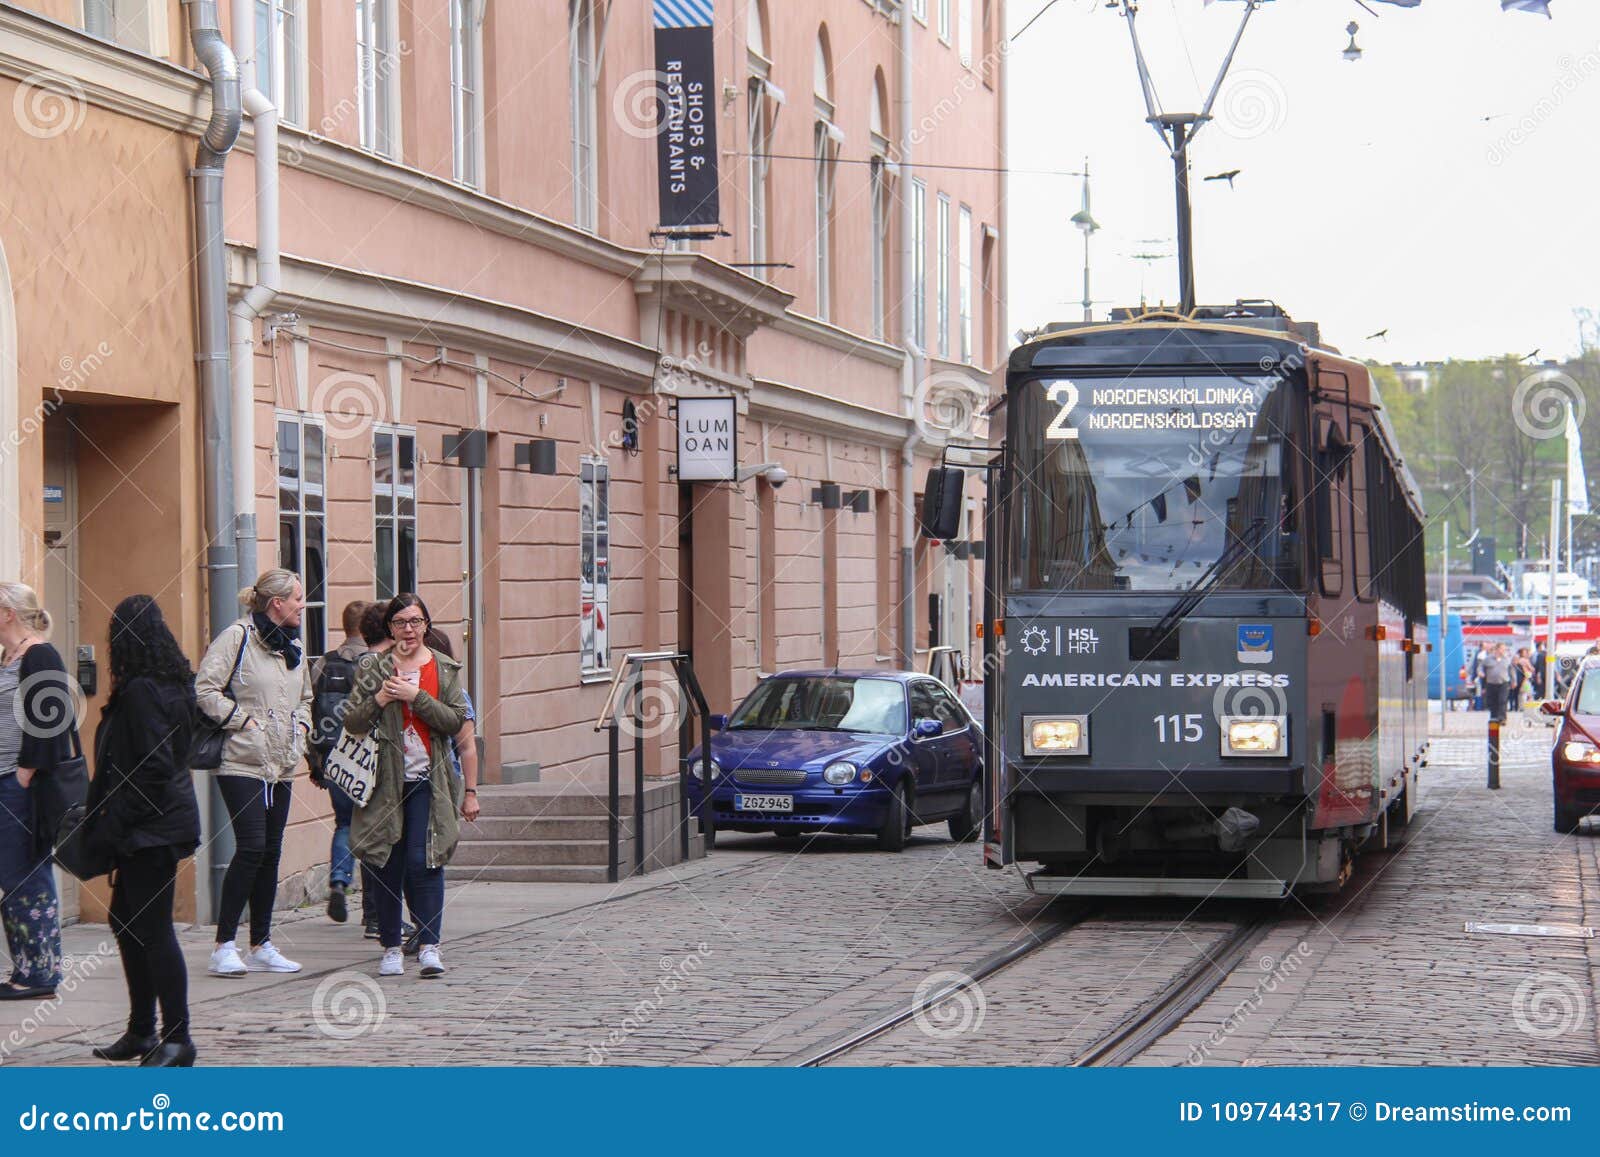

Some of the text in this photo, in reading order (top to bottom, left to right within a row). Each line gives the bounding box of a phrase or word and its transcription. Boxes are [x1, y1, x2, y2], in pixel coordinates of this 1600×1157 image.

[667, 60, 686, 193] RESTAURANTS
[688, 82, 705, 170] SHOPS &
[1093, 388, 1253, 405] NORDENSKIÖLDINKA
[1046, 380, 1079, 439] 2
[686, 419, 728, 433] LUM
[1089, 412, 1257, 429] NORDENSKIÖLDSGAT
[685, 438, 728, 451] OAN
[1068, 628, 1099, 641] HSL
[1068, 642, 1098, 654] HRT
[1021, 673, 1290, 687] AMERICAN EXPRESS
[1153, 713, 1203, 743] 115
[744, 797, 790, 809] ZGZ-945
